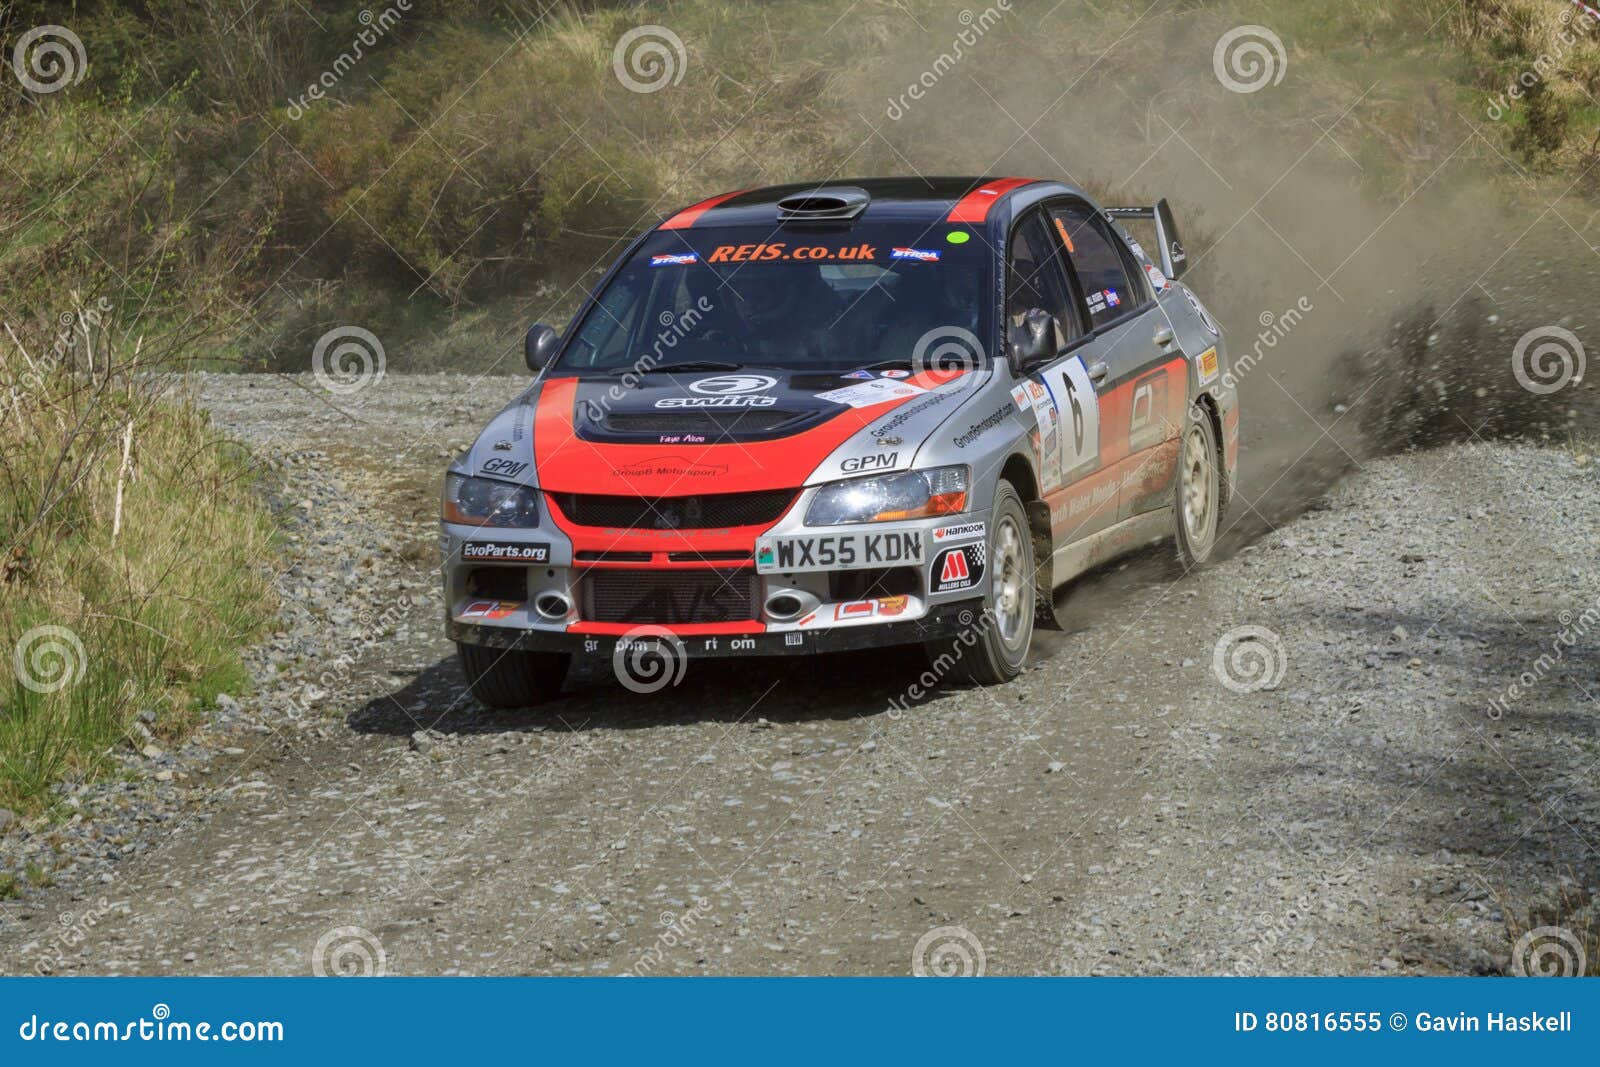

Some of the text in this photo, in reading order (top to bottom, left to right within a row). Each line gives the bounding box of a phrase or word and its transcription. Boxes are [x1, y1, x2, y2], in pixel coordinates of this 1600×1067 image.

[708, 243, 877, 263] REIS.co.uk
[1062, 371, 1084, 457] 6
[483, 457, 529, 478] GPM
[840, 452, 898, 472] GPM
[656, 467, 717, 478] Motorsport
[464, 543, 547, 561] EvoParts.org
[777, 531, 921, 568] WX55 KDN
